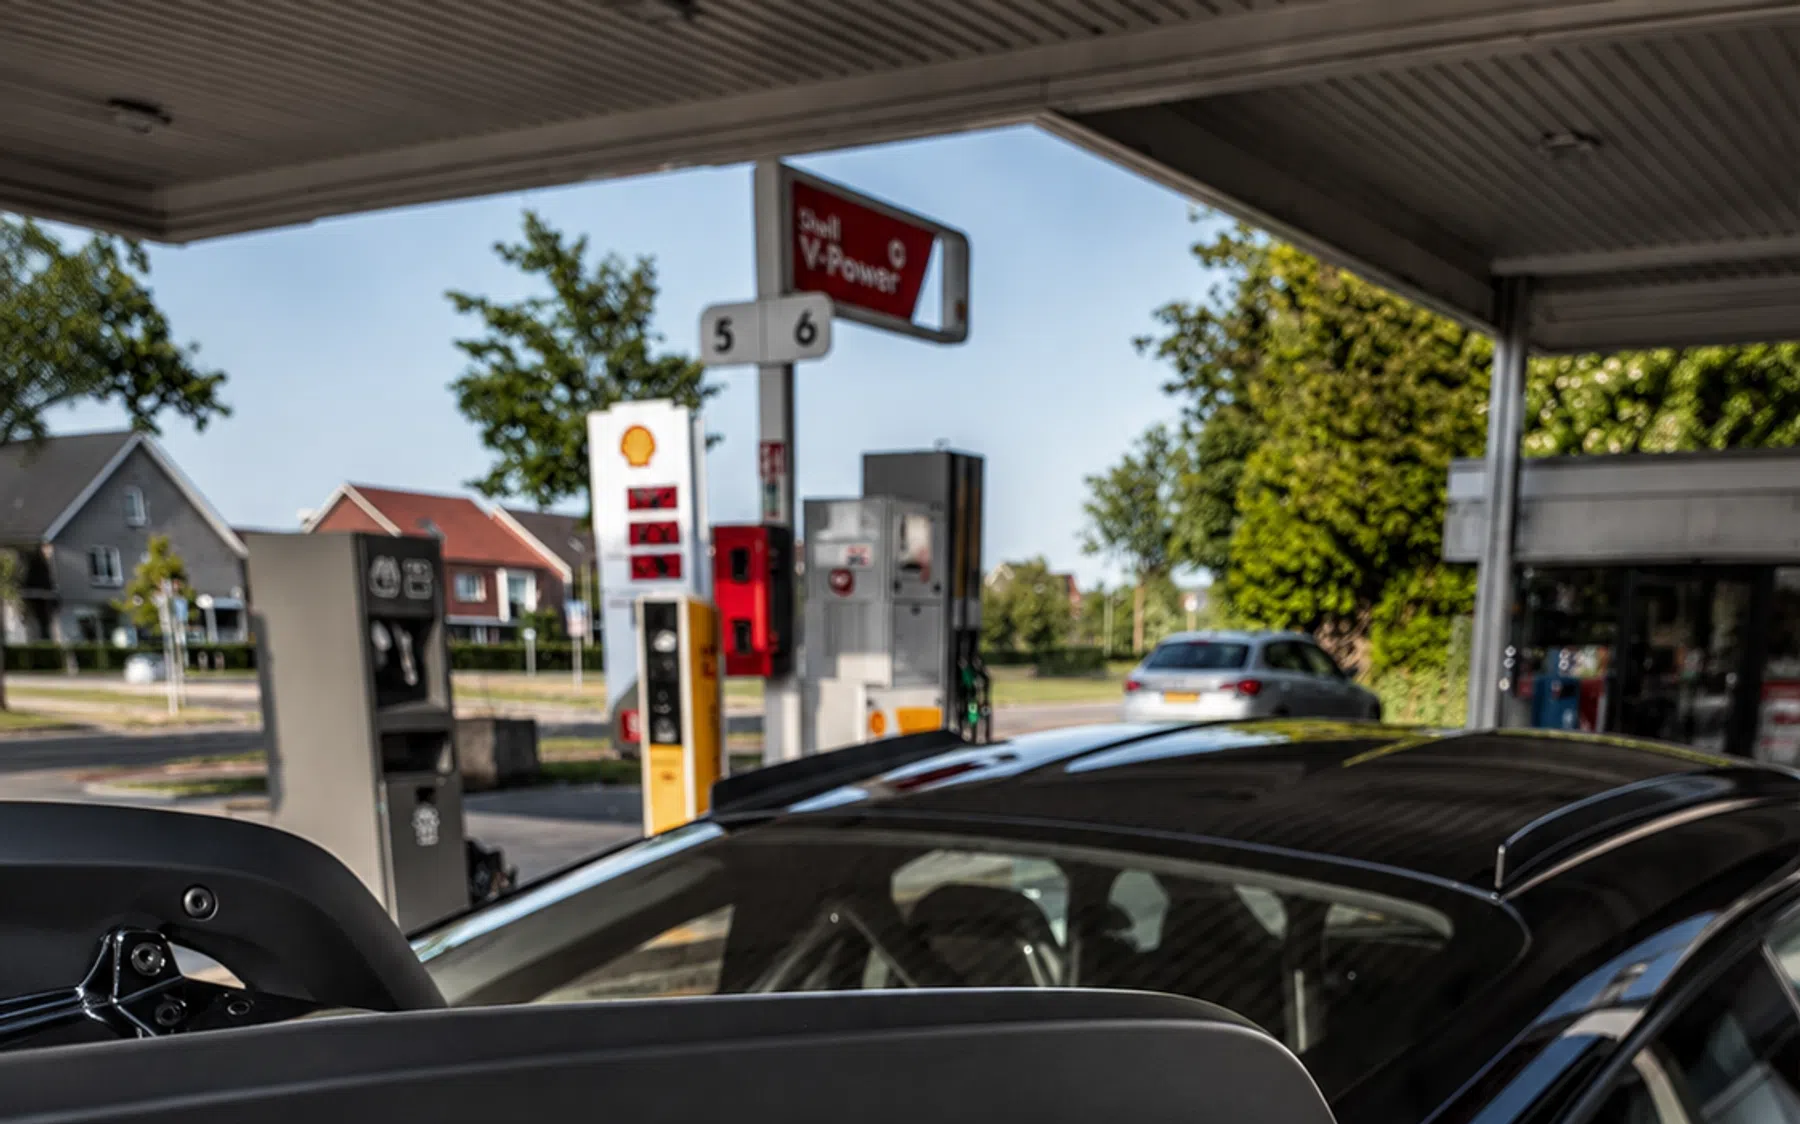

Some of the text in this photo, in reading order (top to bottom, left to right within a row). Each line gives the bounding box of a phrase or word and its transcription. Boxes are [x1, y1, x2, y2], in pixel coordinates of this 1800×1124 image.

[799, 236, 900, 294] V-Power
[714, 310, 818, 355] 5 6
